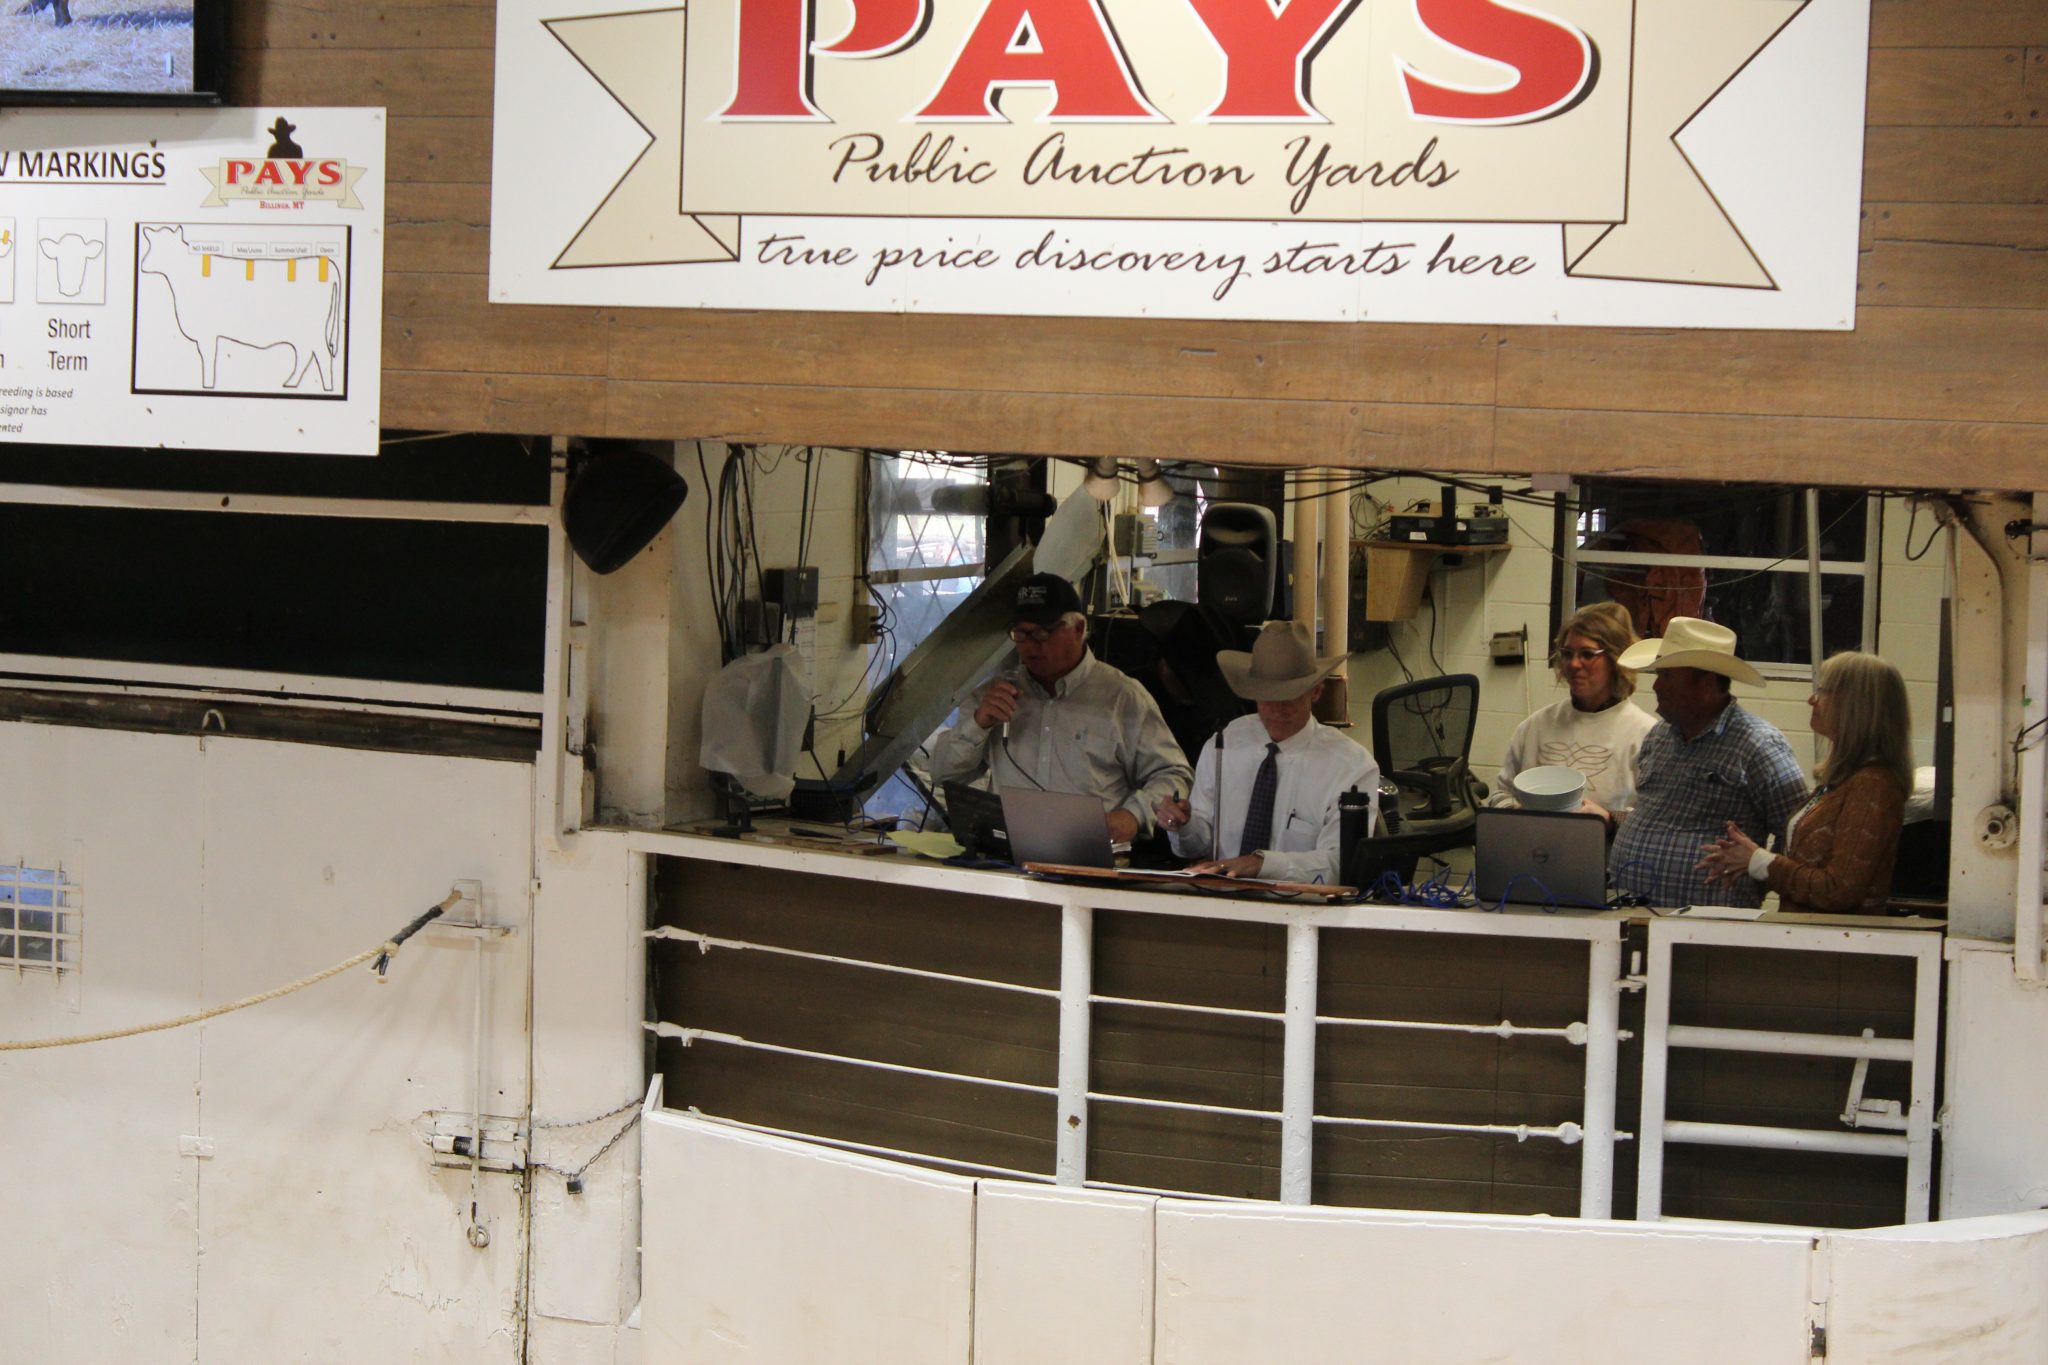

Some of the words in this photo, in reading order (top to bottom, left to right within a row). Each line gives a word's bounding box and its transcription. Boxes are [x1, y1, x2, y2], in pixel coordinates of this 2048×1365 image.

[704, 0, 1602, 125] PAYS
[18, 151, 166, 178] MARKINGS
[225, 159, 343, 185] PAYS
[828, 131, 998, 184] Public
[1022, 131, 1255, 187] Auction
[1284, 134, 1460, 215] Yards
[758, 233, 859, 266] true
[864, 236, 1001, 287] price
[1014, 229, 1252, 301] discovery
[1262, 239, 1417, 275] starts
[1426, 232, 1537, 276] here
[47, 318, 91, 339] Short
[48, 350, 88, 371] Term
[36, 387, 44, 398] is
[45, 387, 74, 398] based
[0, 404, 30, 417] signor
[31, 405, 48, 416] has
